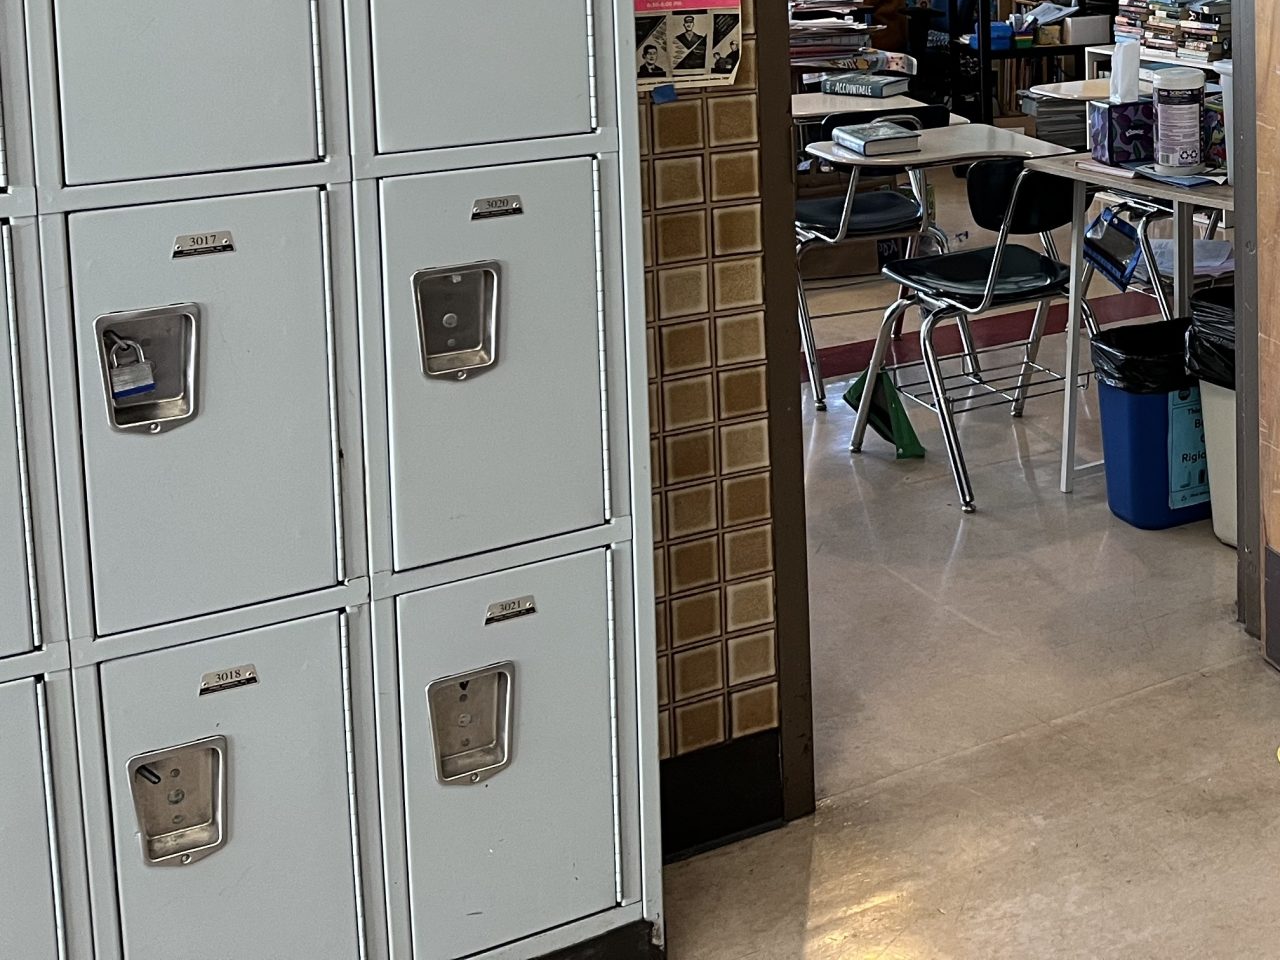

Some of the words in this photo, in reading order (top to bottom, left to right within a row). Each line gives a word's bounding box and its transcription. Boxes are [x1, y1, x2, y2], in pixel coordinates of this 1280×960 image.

[834, 82, 873, 96] ACCOUNTABLE
[486, 198, 509, 210] 3020
[188, 234, 217, 247] 3017
[499, 600, 521, 614] 3021
[215, 669, 242, 684] 3018
